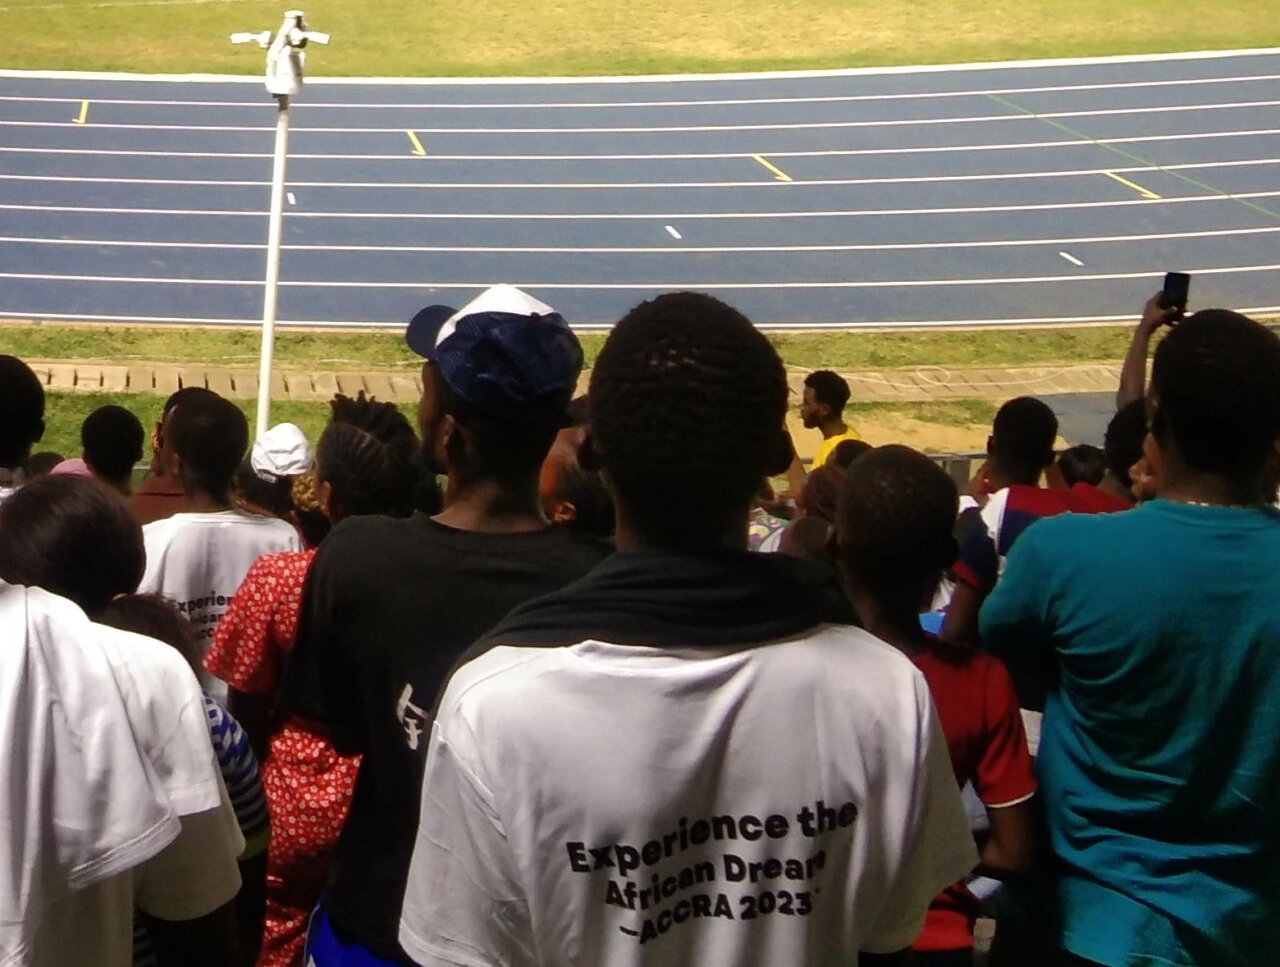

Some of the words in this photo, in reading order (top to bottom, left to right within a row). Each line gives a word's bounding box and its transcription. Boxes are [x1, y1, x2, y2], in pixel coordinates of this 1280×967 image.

[566, 813, 789, 877] Experience
[797, 800, 858, 838] the
[605, 860, 715, 910] African
